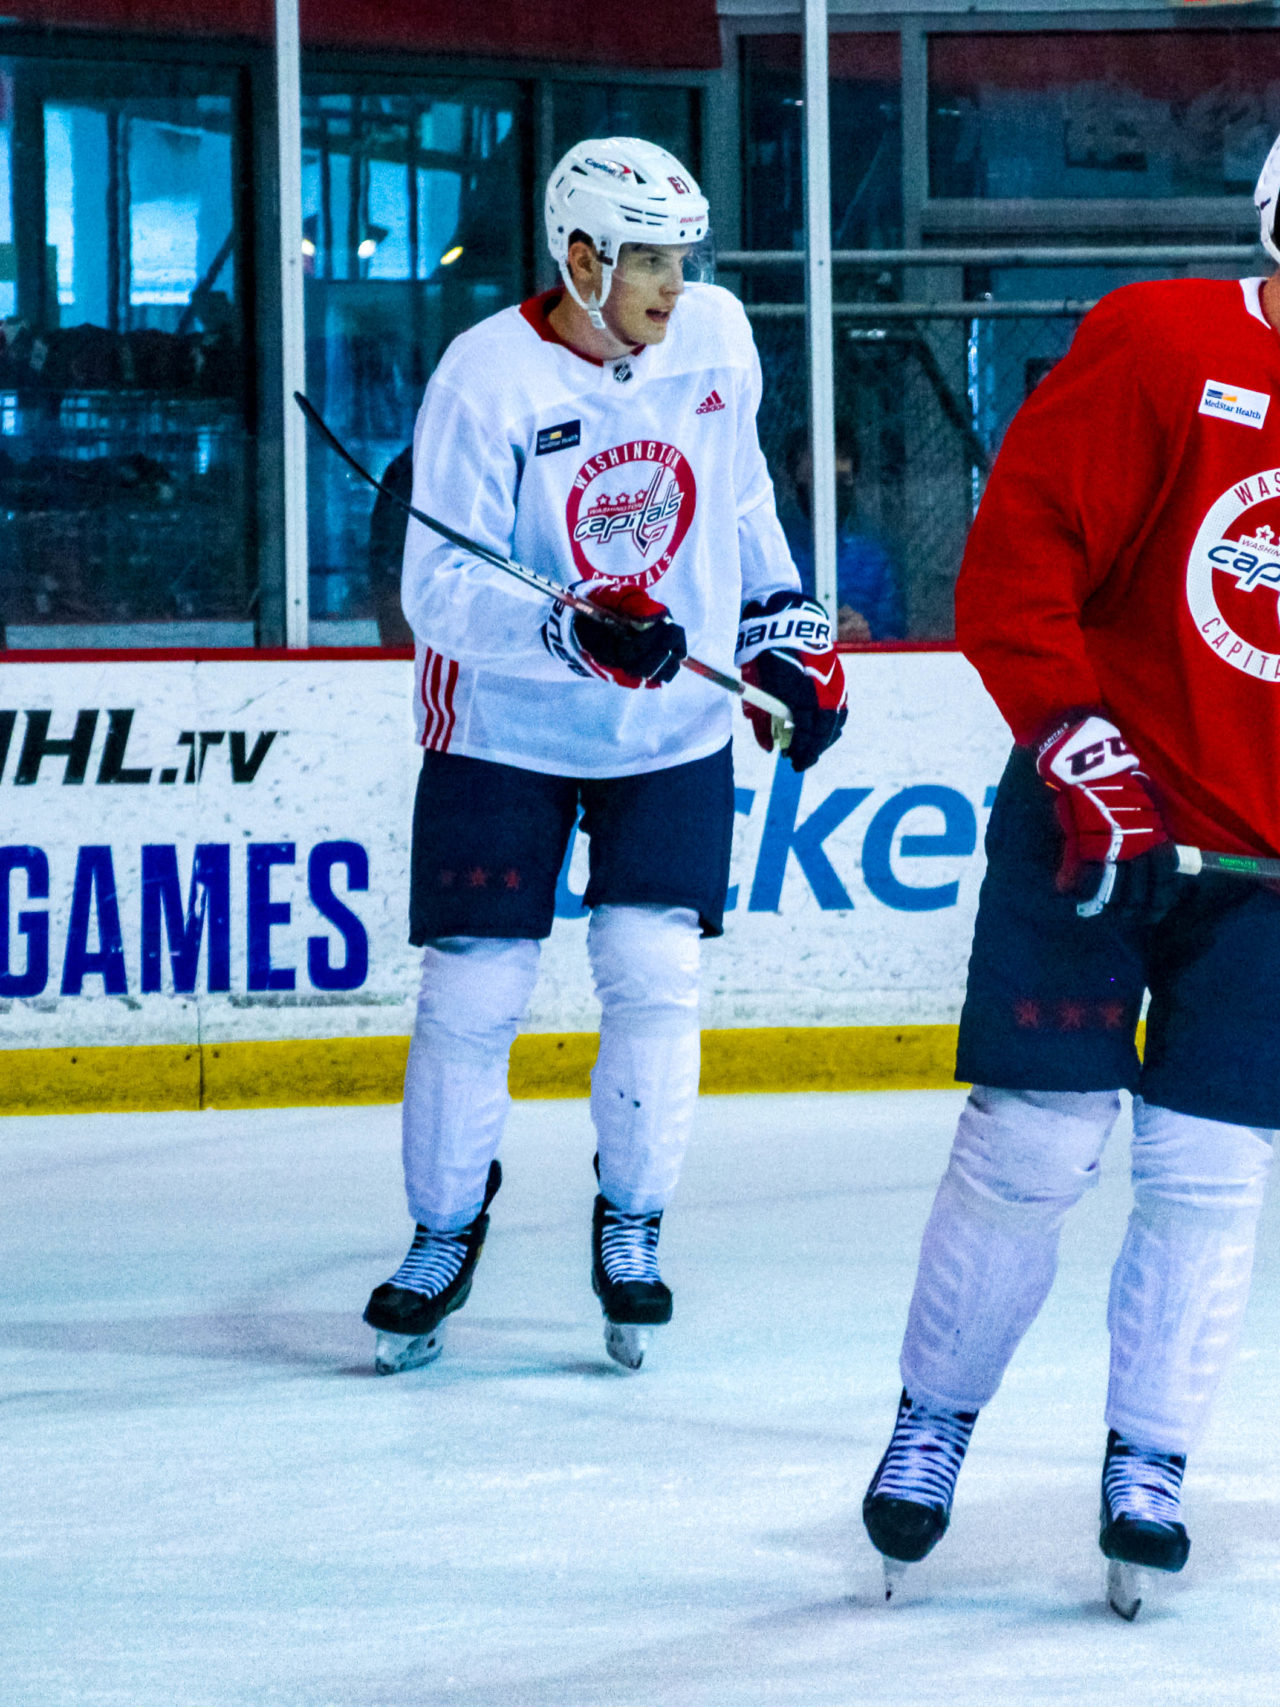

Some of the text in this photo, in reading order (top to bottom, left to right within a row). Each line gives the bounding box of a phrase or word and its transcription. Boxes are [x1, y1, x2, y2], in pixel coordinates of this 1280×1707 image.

[1205, 399, 1261, 420] MedStar Health
[574, 442, 682, 491] WASHINGTON
[0, 841, 369, 999] GAMES
